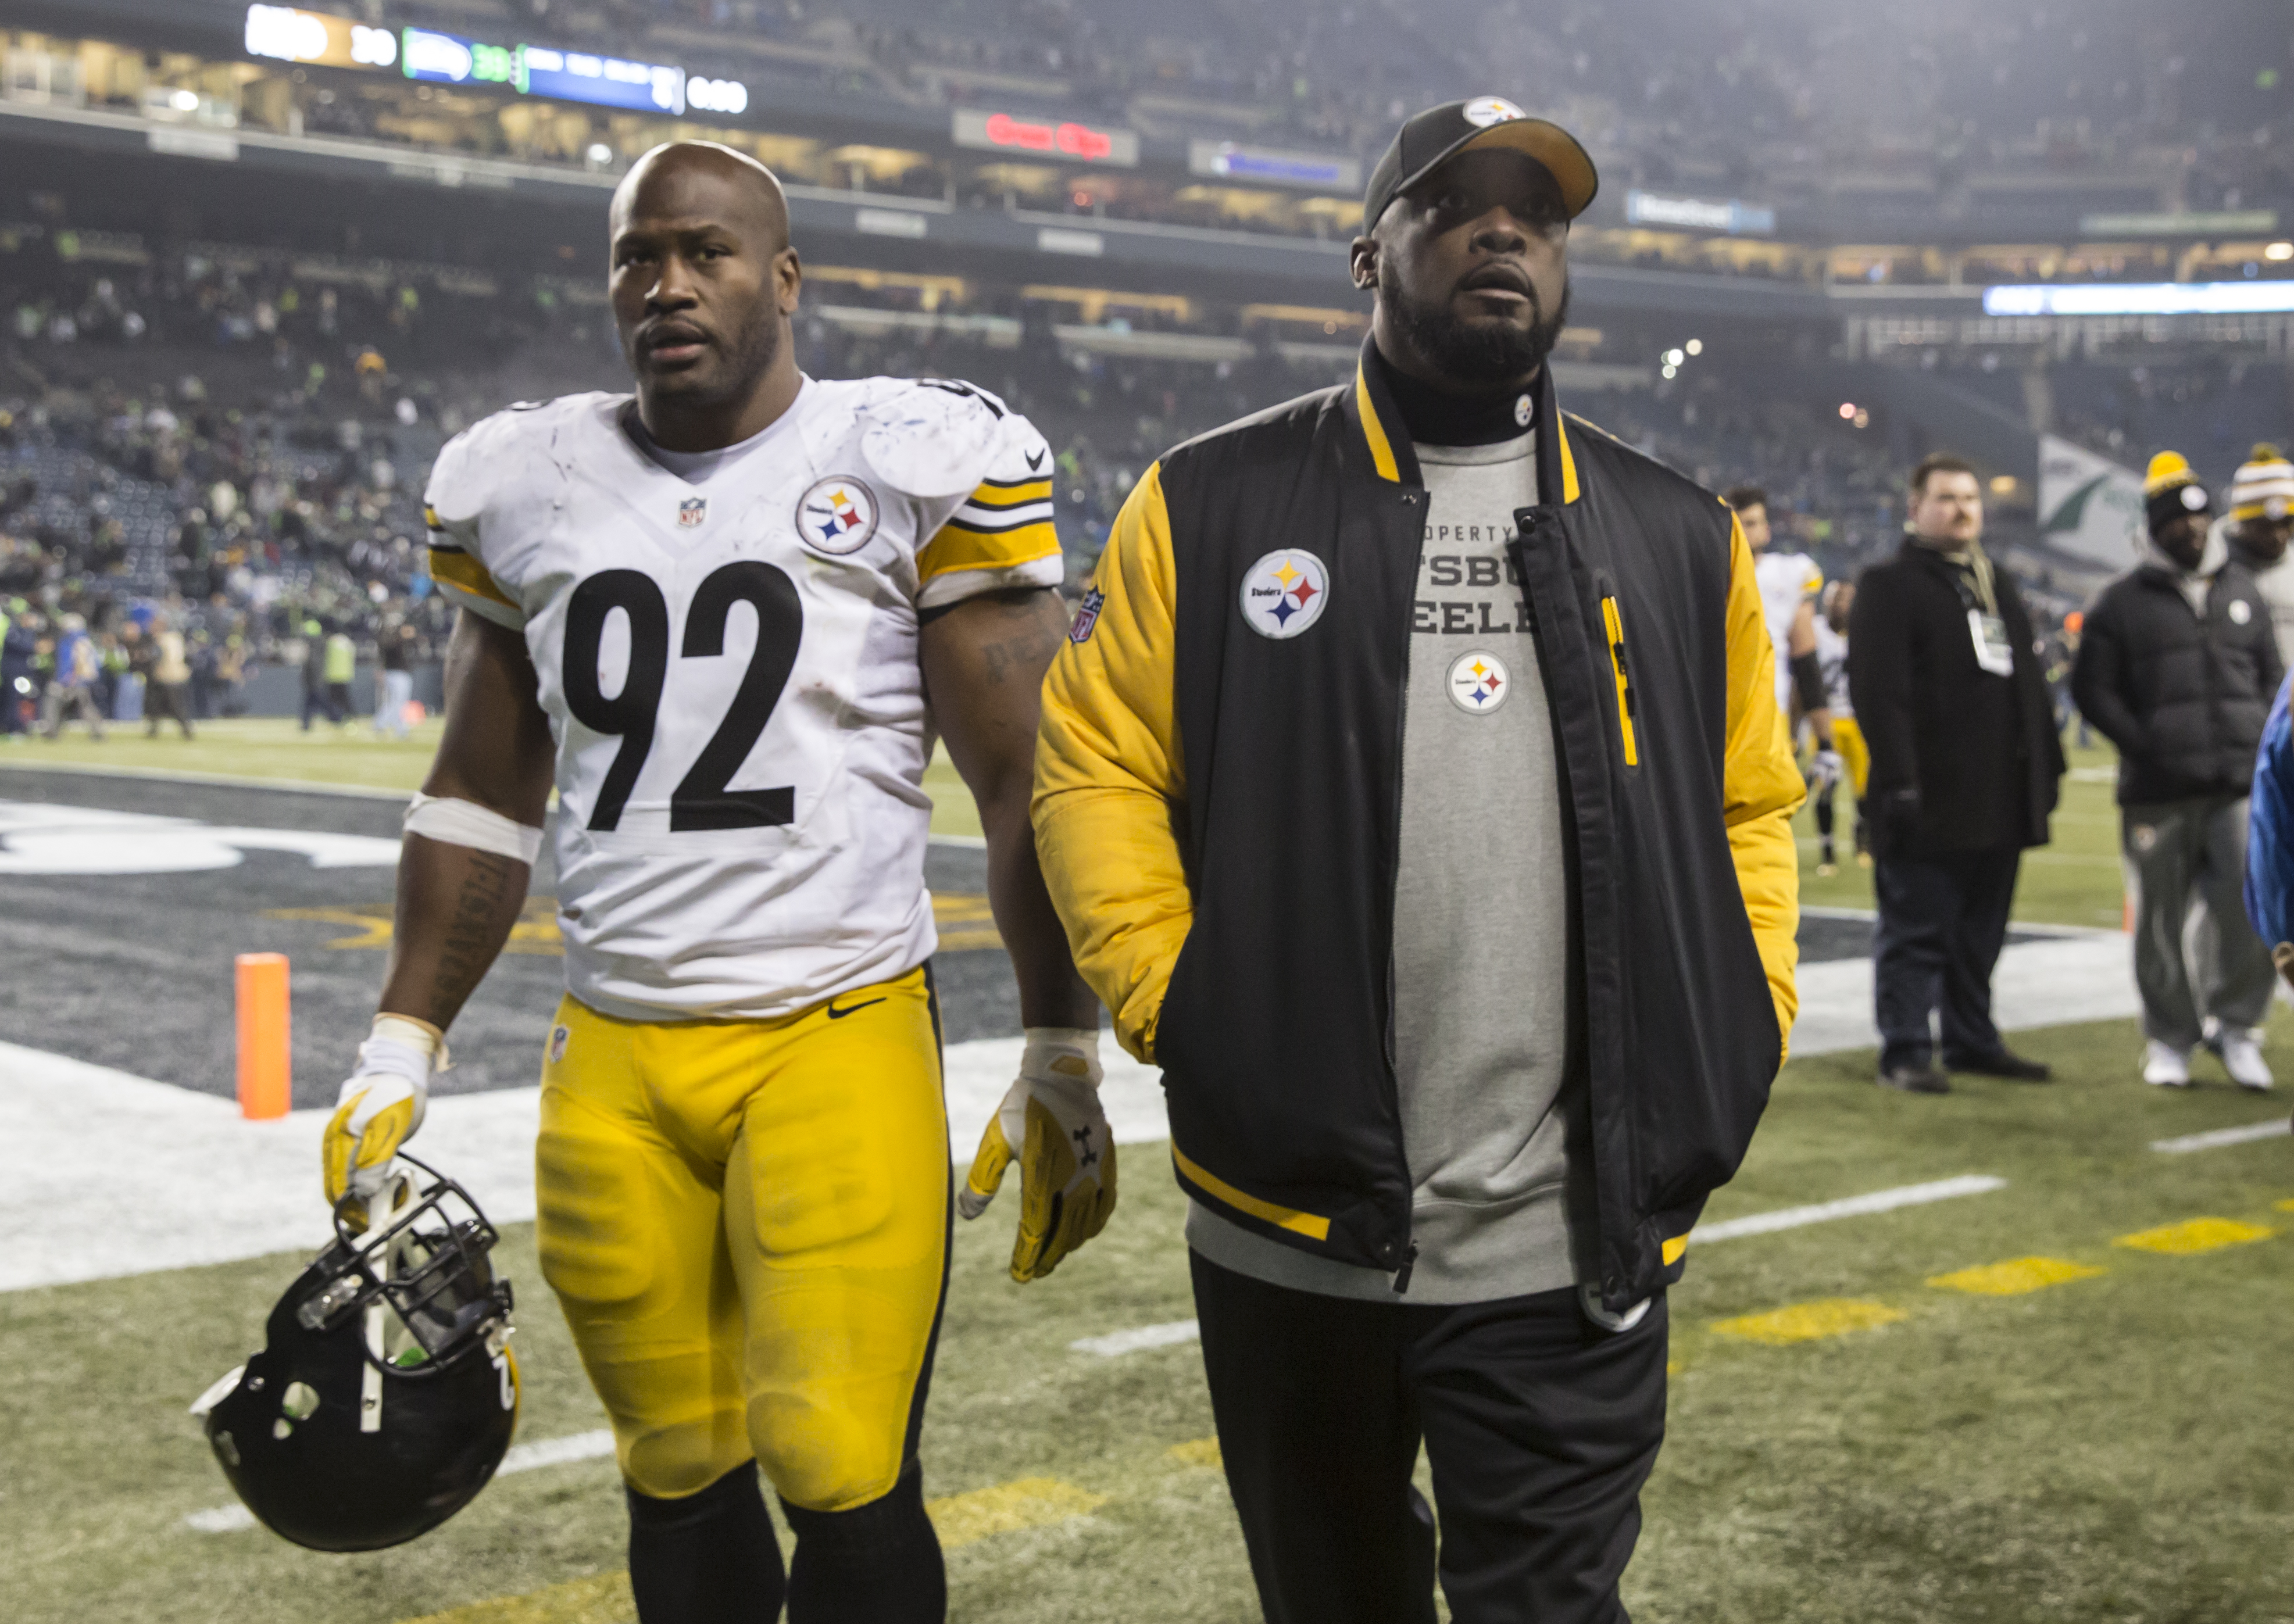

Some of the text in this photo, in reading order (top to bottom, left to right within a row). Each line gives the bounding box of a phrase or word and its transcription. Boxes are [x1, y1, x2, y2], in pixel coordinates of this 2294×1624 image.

[1420, 555, 1521, 586] SB
[1251, 586, 1281, 597] Steelers
[563, 560, 803, 832] 92
